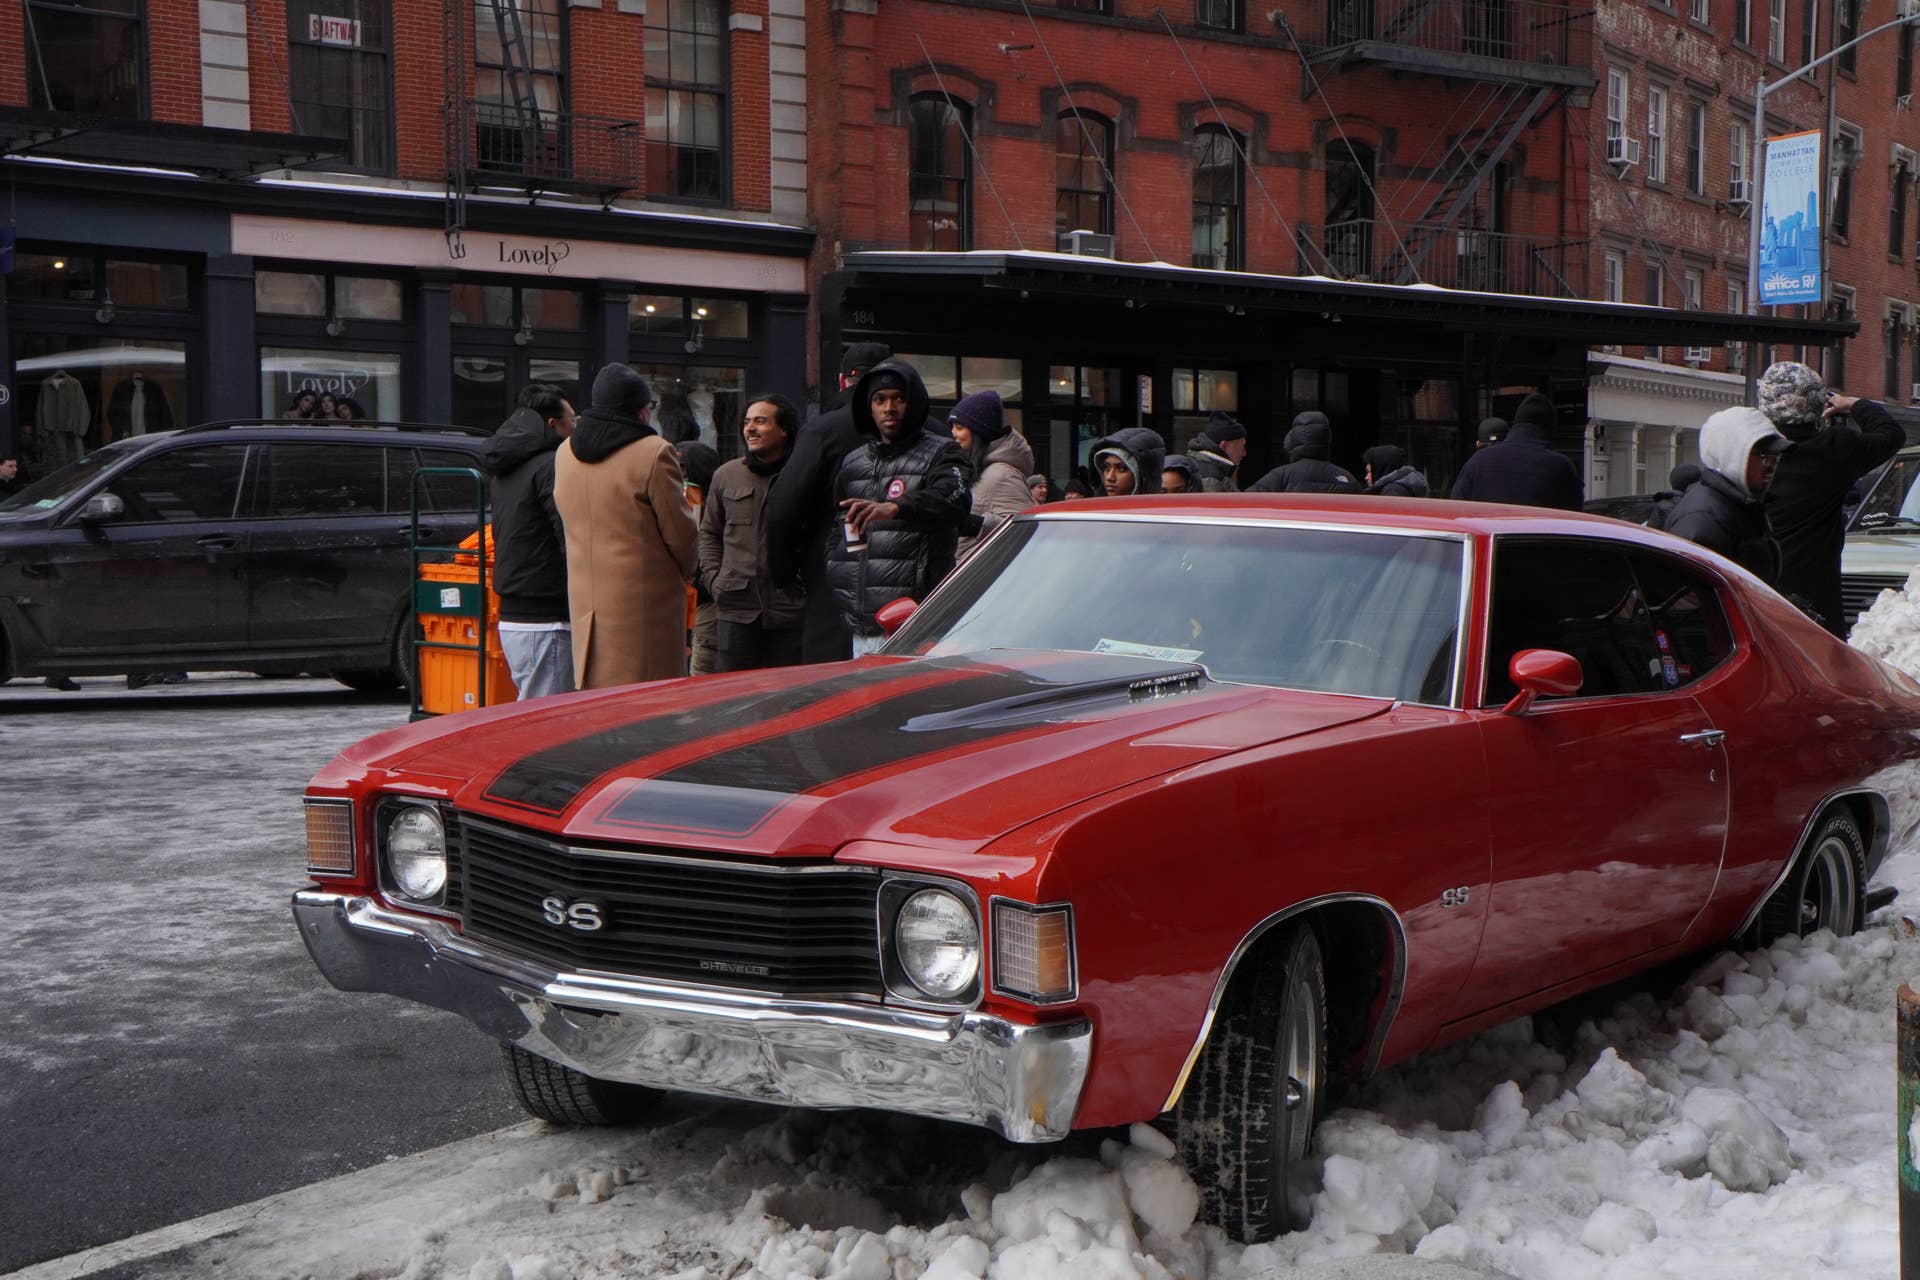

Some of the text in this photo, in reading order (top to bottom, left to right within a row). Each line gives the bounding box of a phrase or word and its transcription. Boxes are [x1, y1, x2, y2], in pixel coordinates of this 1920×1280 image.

[1771, 146, 1815, 160] MANHATTAN
[1769, 165, 1815, 179] COLLEGE
[499, 241, 570, 274] Lovely
[852, 311, 875, 324] 184
[287, 369, 370, 400] Lovely
[1442, 886, 1470, 909] SS
[542, 896, 603, 931] SS
[700, 960, 770, 976] CHEVELLE
